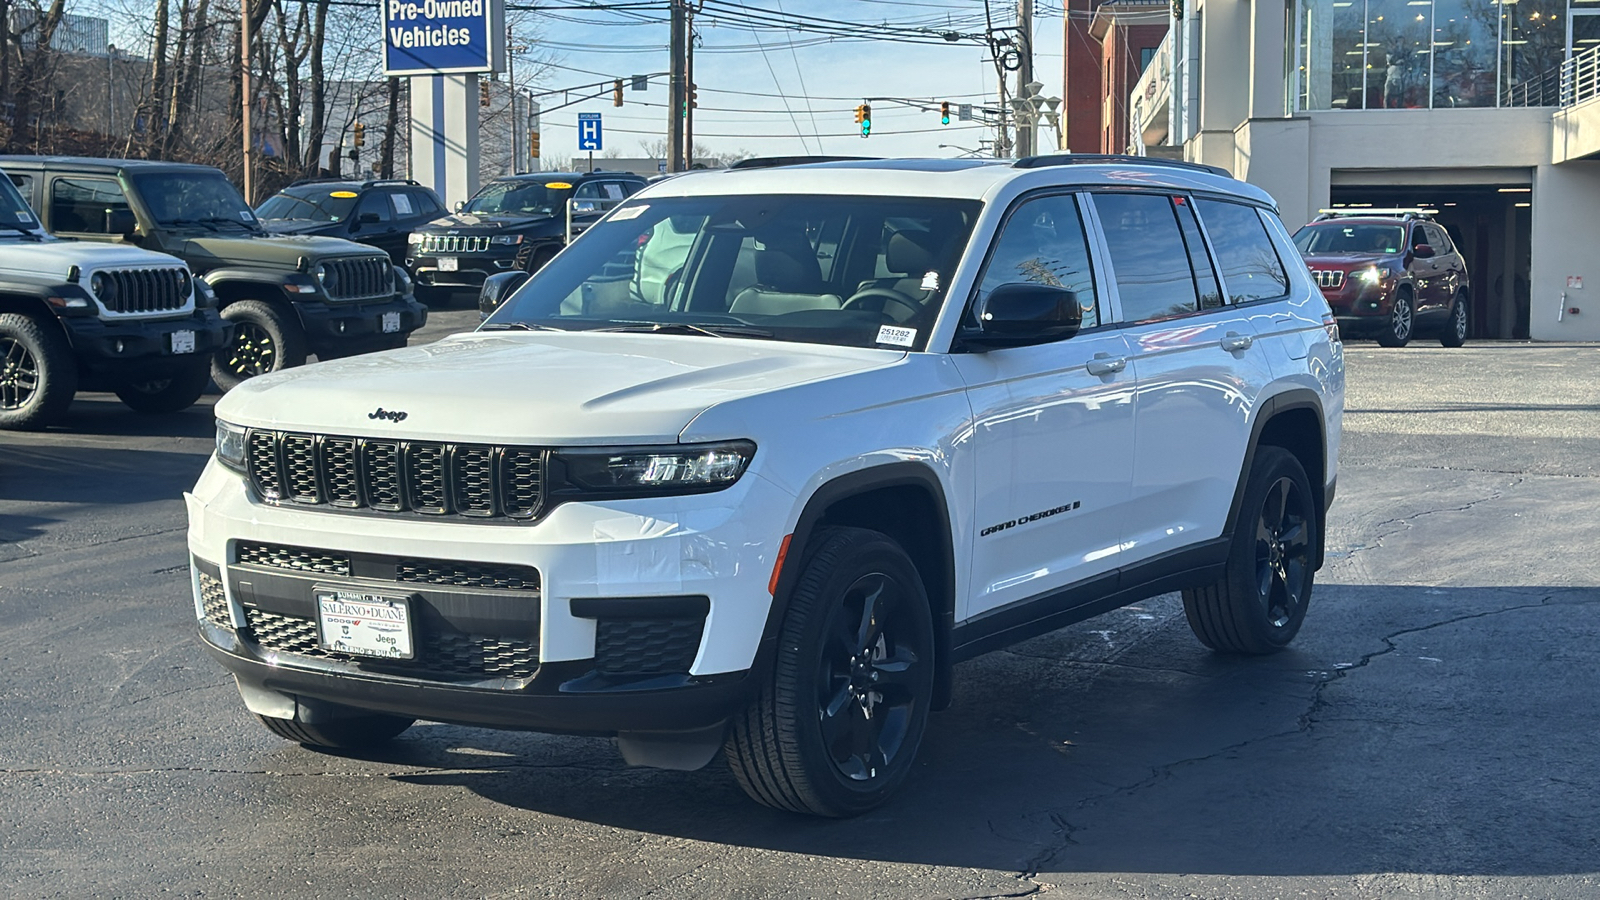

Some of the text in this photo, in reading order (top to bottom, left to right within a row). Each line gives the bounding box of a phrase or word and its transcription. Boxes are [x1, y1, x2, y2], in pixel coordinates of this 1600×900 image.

[389, 0, 483, 20] Pre-Owned
[390, 25, 470, 48] Vehicles
[583, 121, 597, 139] H
[881, 328, 910, 338] 251282
[368, 407, 408, 423] Jeep
[980, 519, 1017, 537] GRAND
[1017, 503, 1071, 525] CHEROKEE
[322, 603, 404, 621] SALERNO DUANE
[376, 634, 396, 645] Jeep
[331, 644, 401, 658] SALERNO DUANE
